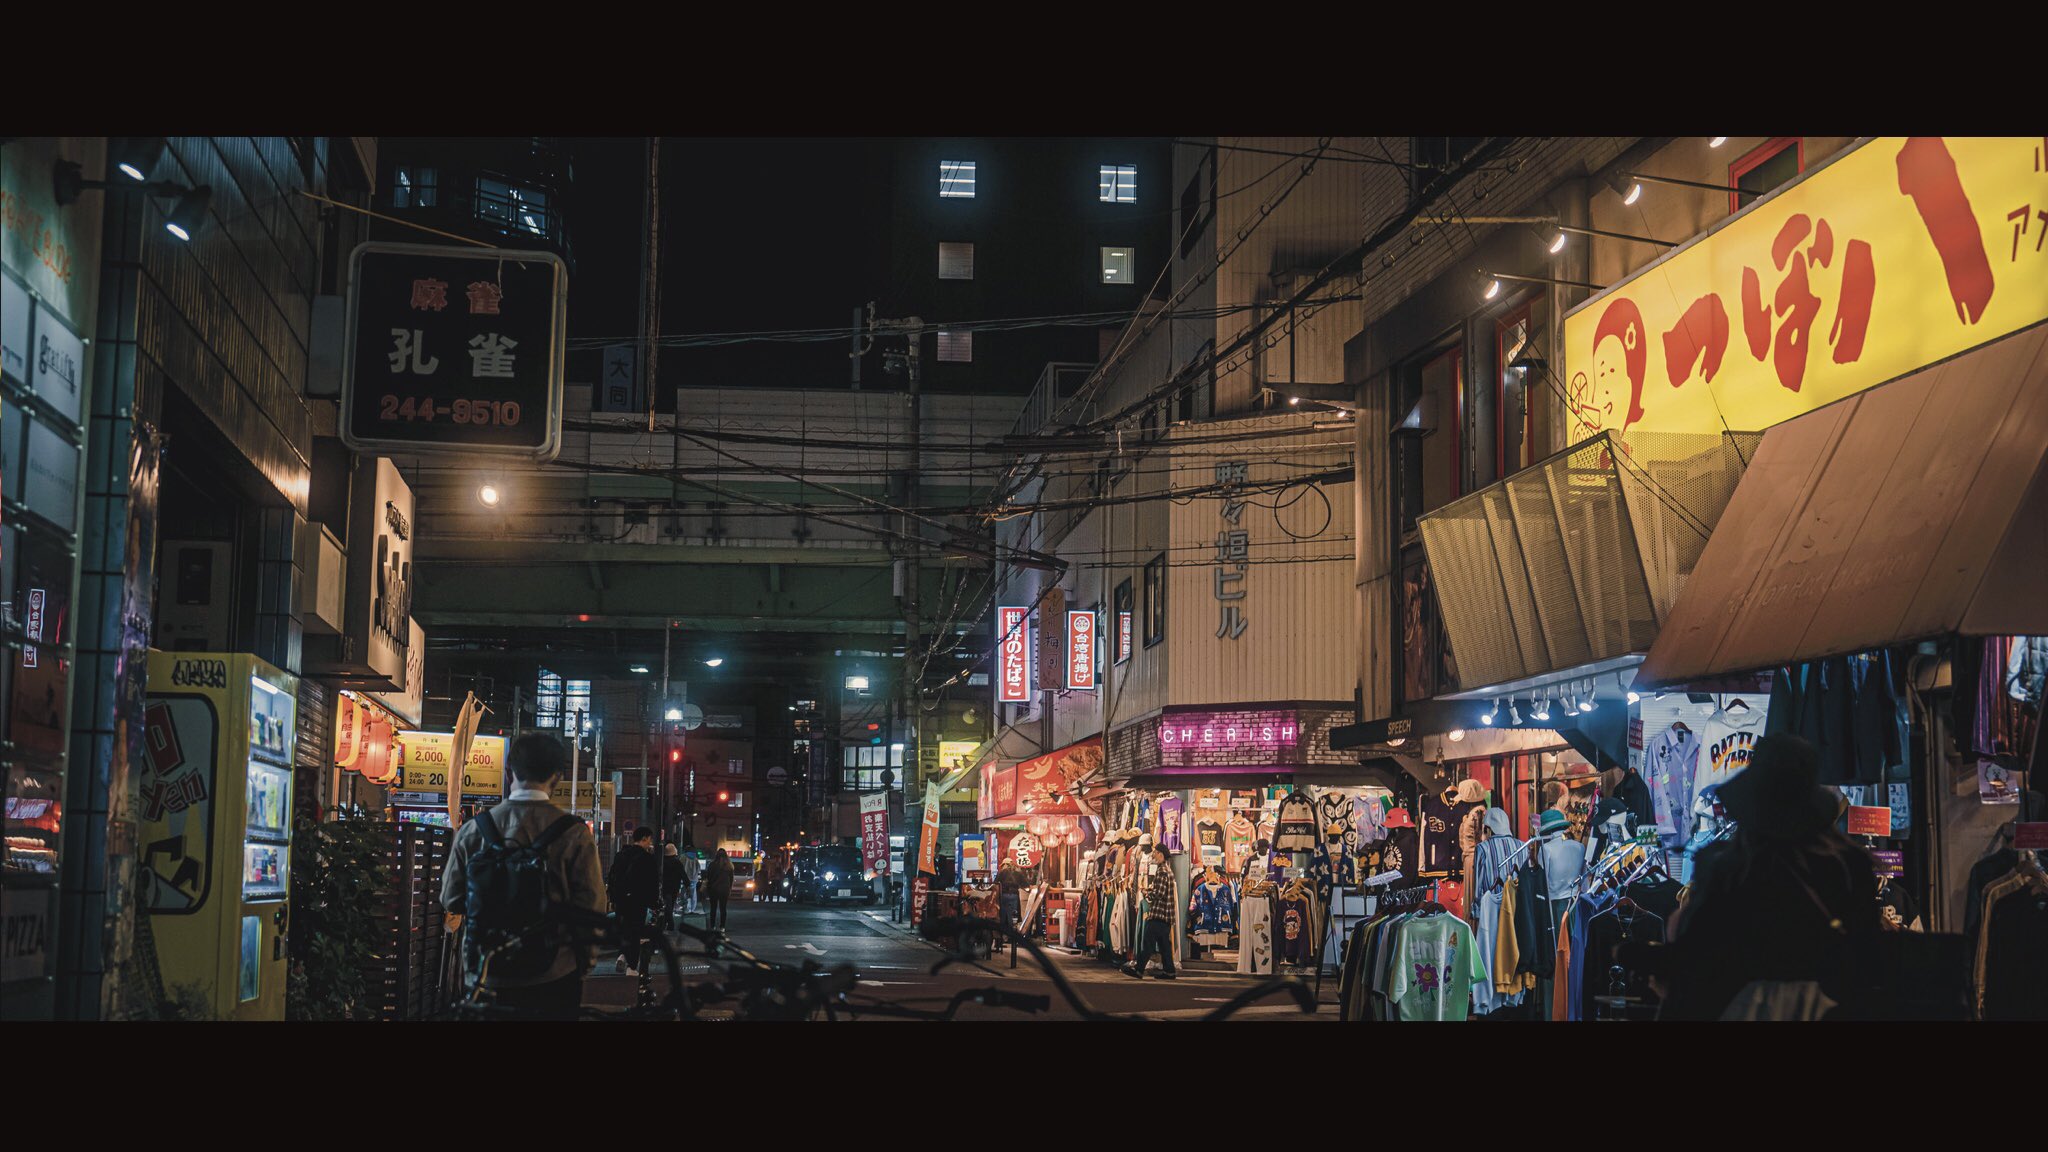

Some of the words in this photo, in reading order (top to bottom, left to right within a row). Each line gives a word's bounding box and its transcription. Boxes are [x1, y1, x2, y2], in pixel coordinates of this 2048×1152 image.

[410, 278, 504, 315] 麻雀
[387, 327, 519, 379] 孔雀
[379, 394, 521, 427] 244-9510
[1005, 611, 1023, 697] 世界のたばこ
[1073, 633, 1091, 683] 台湾唐揚げ
[1162, 726, 1294, 743] CHERISH
[1387, 719, 1412, 736] SPEECH
[1710, 731, 1761, 770] BATTL
